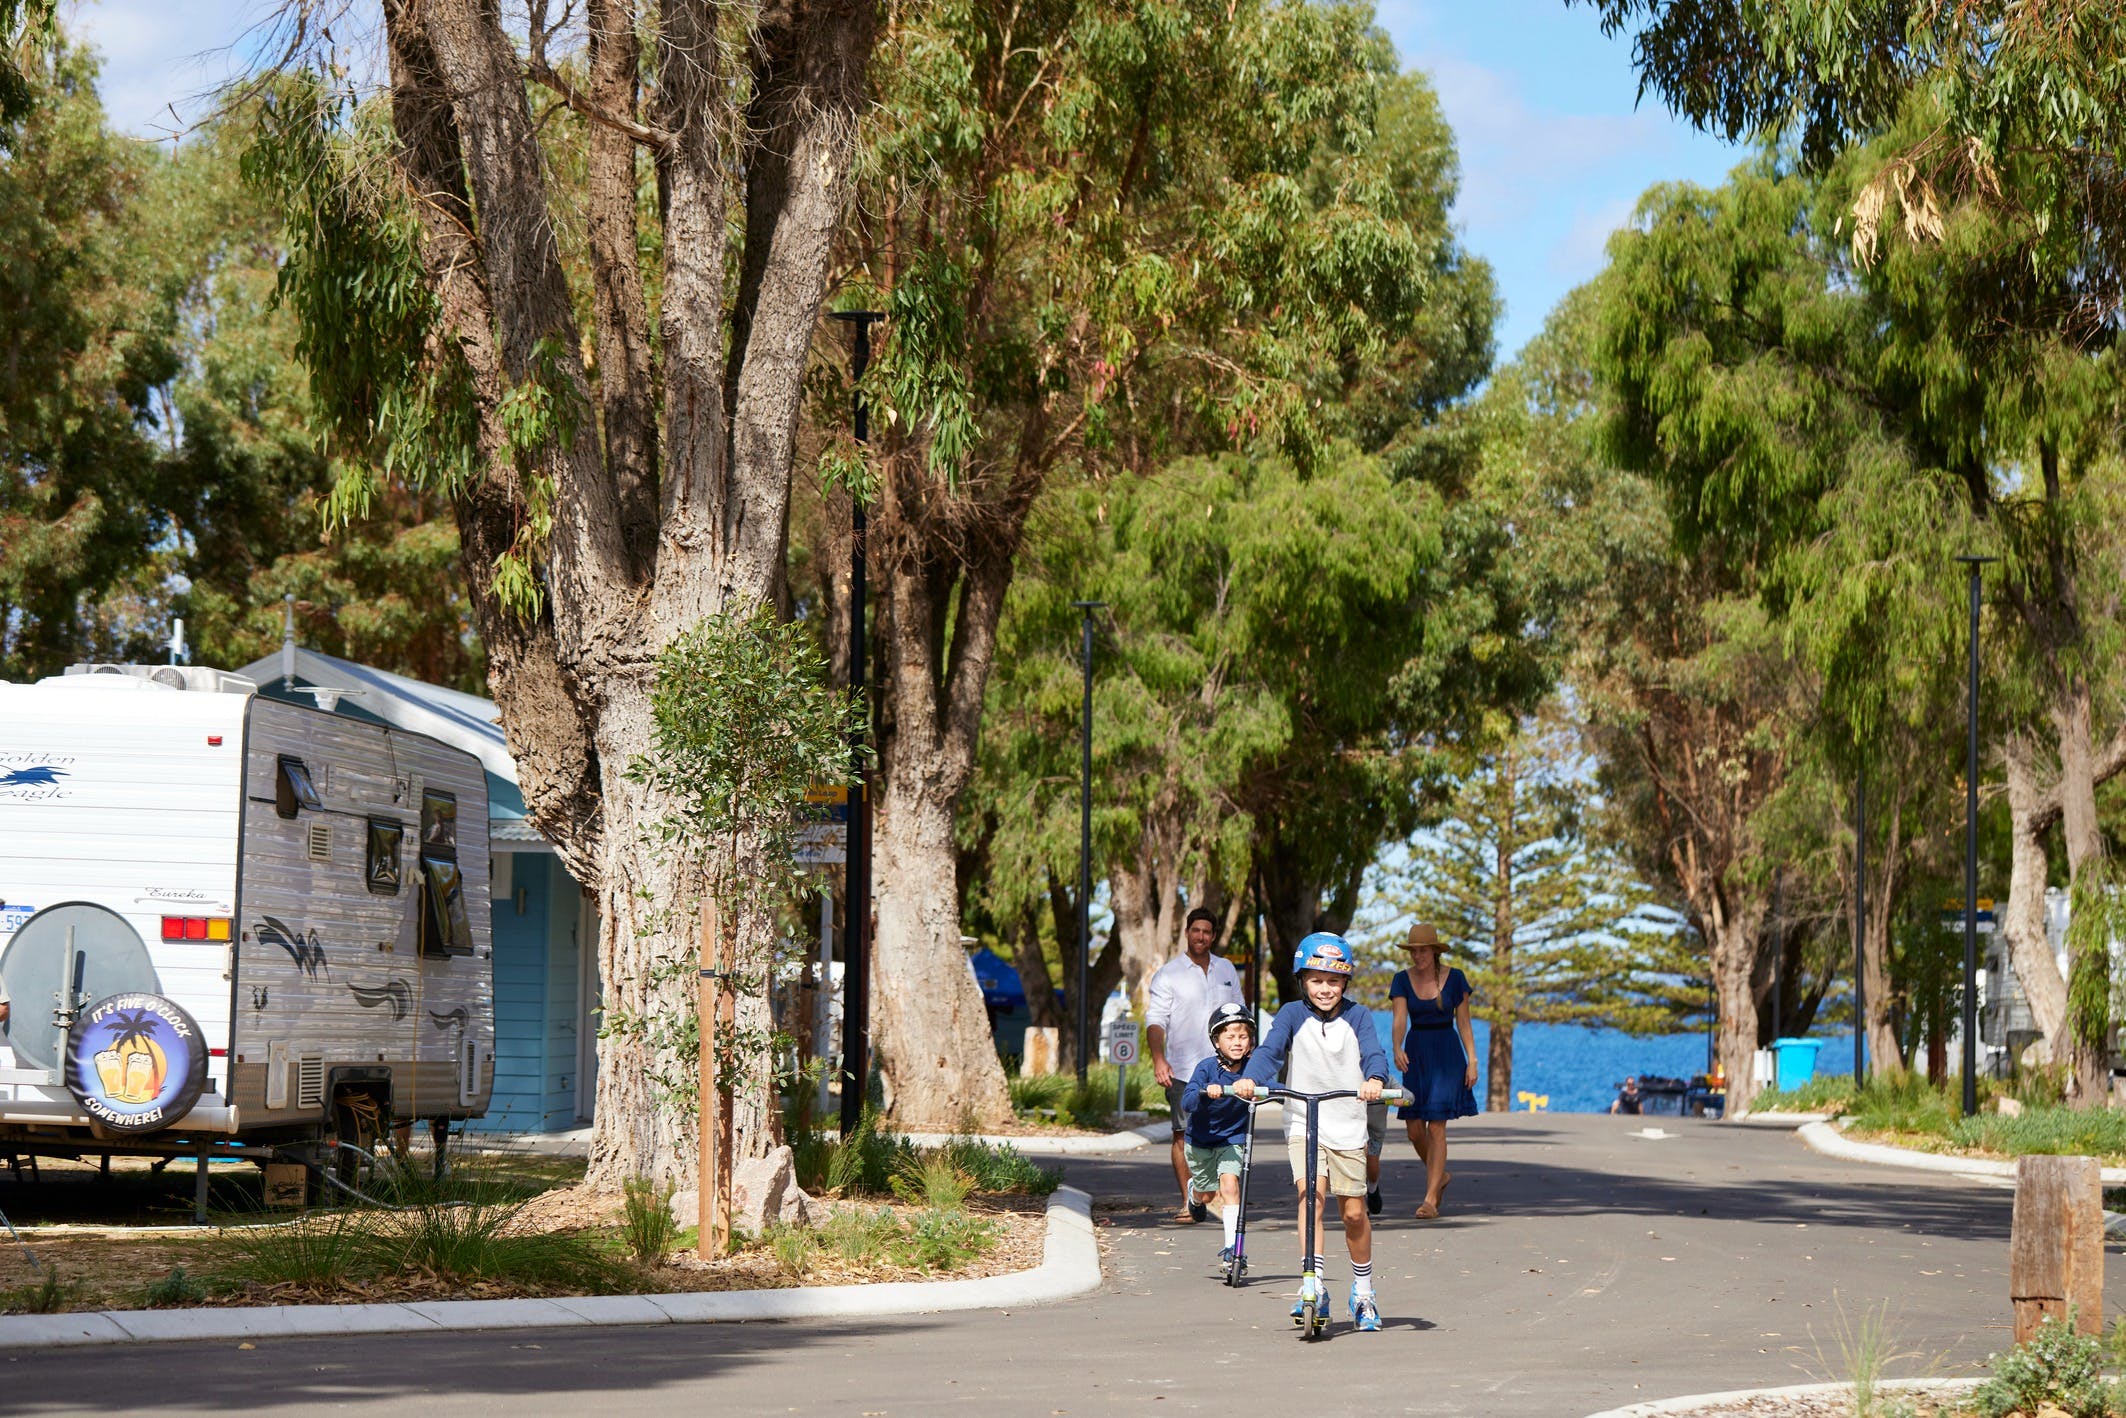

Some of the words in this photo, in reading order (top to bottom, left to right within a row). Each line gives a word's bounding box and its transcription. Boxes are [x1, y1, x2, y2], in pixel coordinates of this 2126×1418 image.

[145, 886, 208, 899] Eureka
[91, 1002, 115, 1024] IT'S
[116, 998, 145, 1011] FIVE
[145, 1001, 192, 1038] O'CLOCK
[1120, 1045, 1128, 1057] 8
[84, 1097, 163, 1126] SOMEWHERE!
